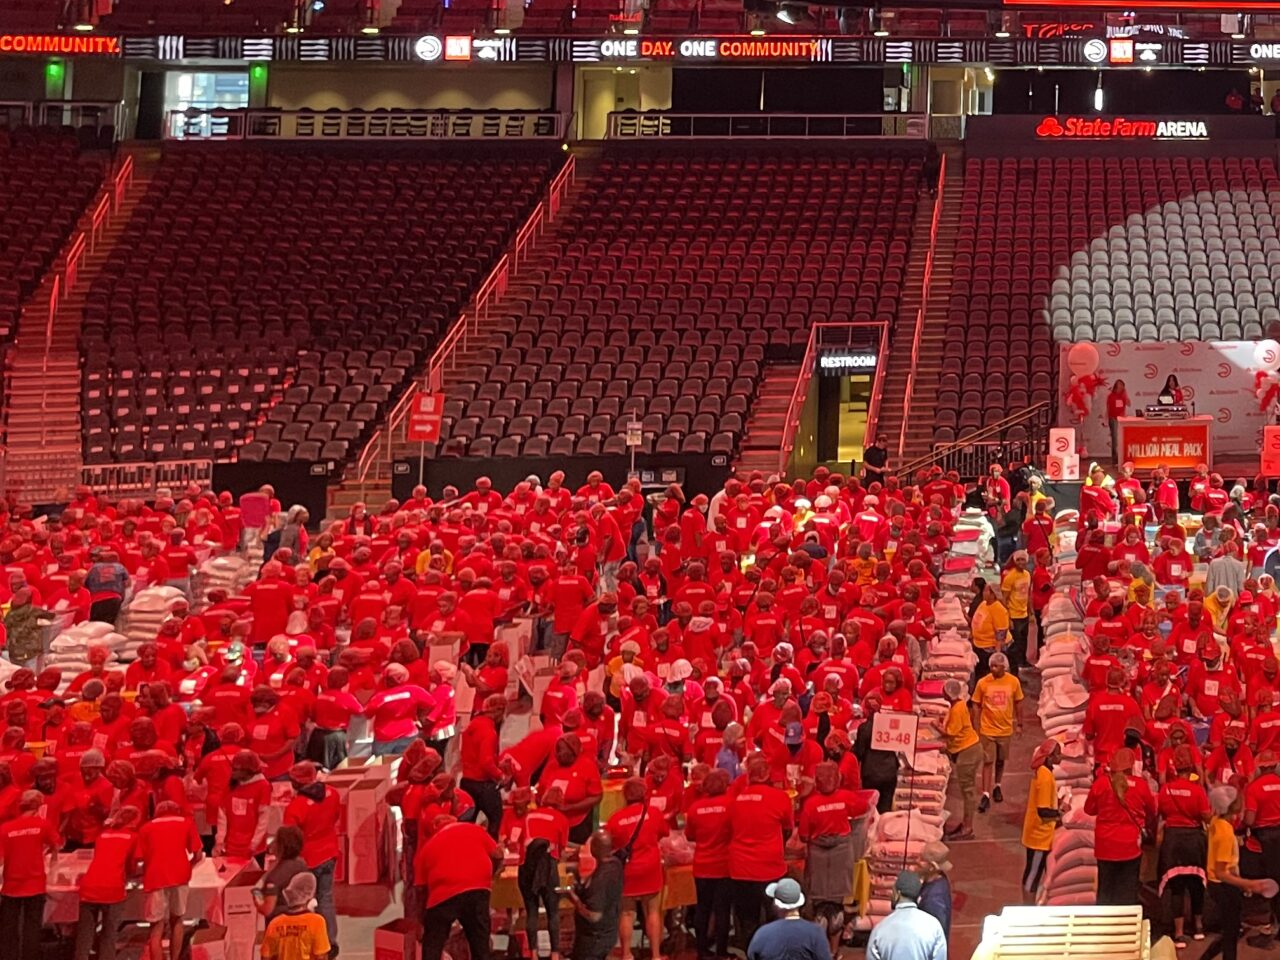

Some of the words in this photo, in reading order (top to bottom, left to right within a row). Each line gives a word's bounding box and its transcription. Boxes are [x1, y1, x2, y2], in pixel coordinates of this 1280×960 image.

[0, 36, 120, 53] COMMUNITY.
[600, 41, 637, 57] ONE
[641, 41, 675, 56] DAY.
[680, 41, 715, 57] ONE
[1157, 120, 1208, 137] ARENA
[820, 355, 877, 368] RESTROOM
[1128, 443, 1159, 458] MILLION
[1160, 443, 1182, 457] MEAL
[1183, 443, 1204, 457] PACK
[875, 730, 911, 745] 33-48
